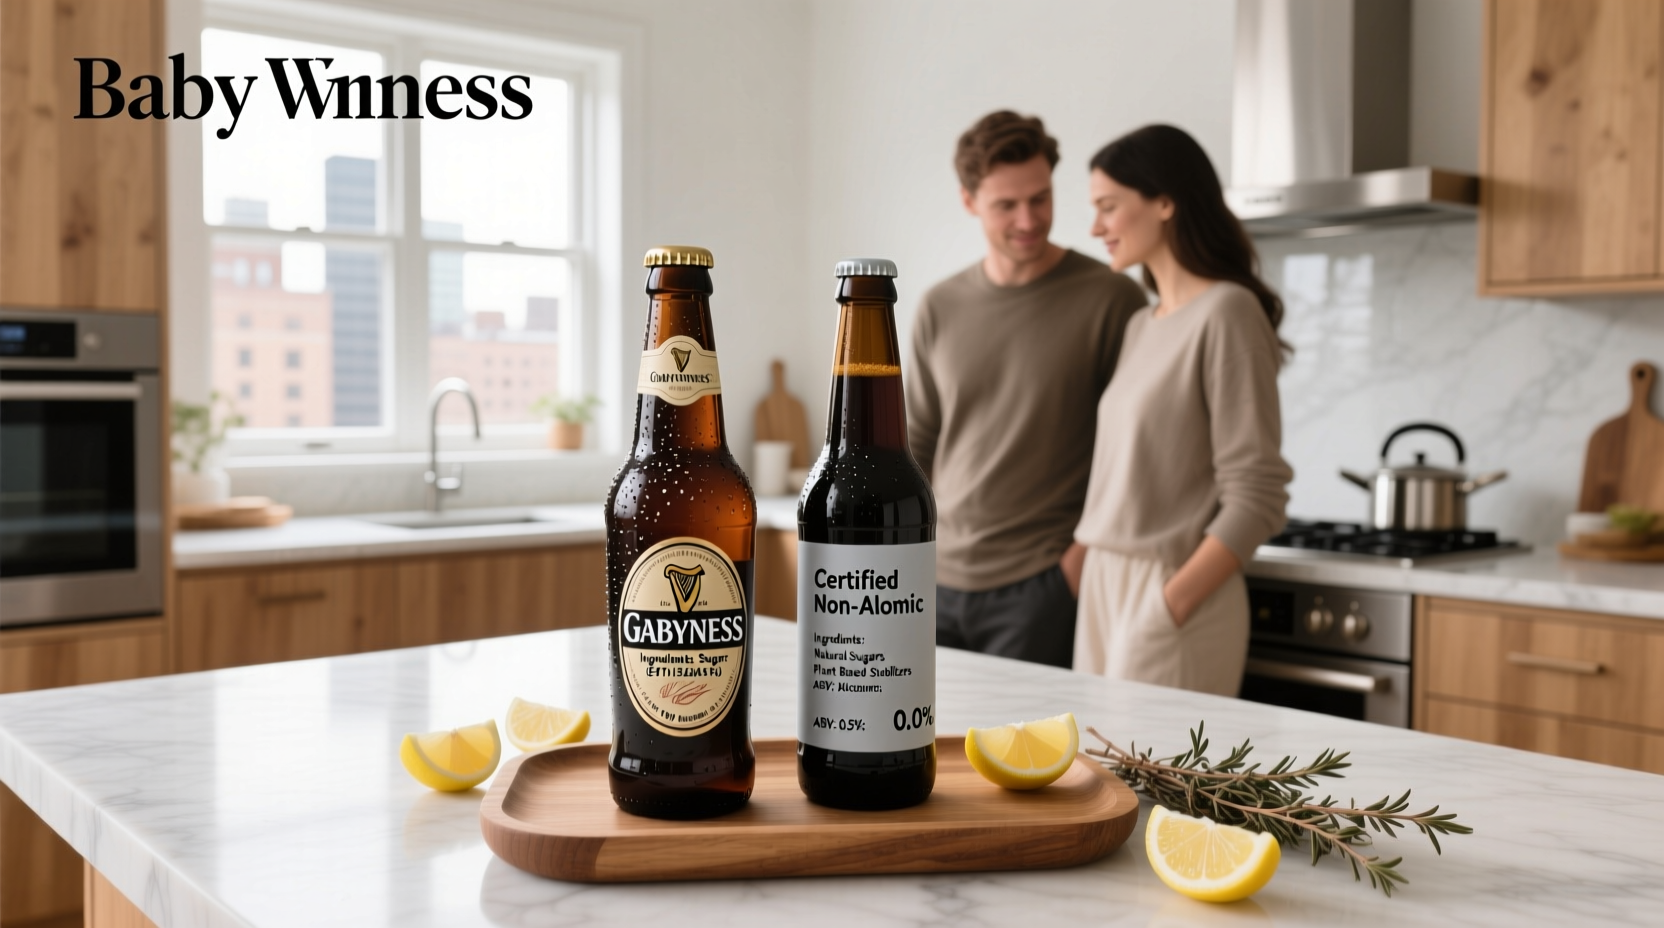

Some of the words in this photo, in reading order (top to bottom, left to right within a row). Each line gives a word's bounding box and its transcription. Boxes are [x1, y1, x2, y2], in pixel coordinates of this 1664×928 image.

[814, 568, 898, 590] Certified
[814, 593, 924, 615] Non-Alomic
[623, 612, 743, 644] GABYNESS
[813, 664, 836, 676] Plant
[893, 704, 934, 731] 0.0%
